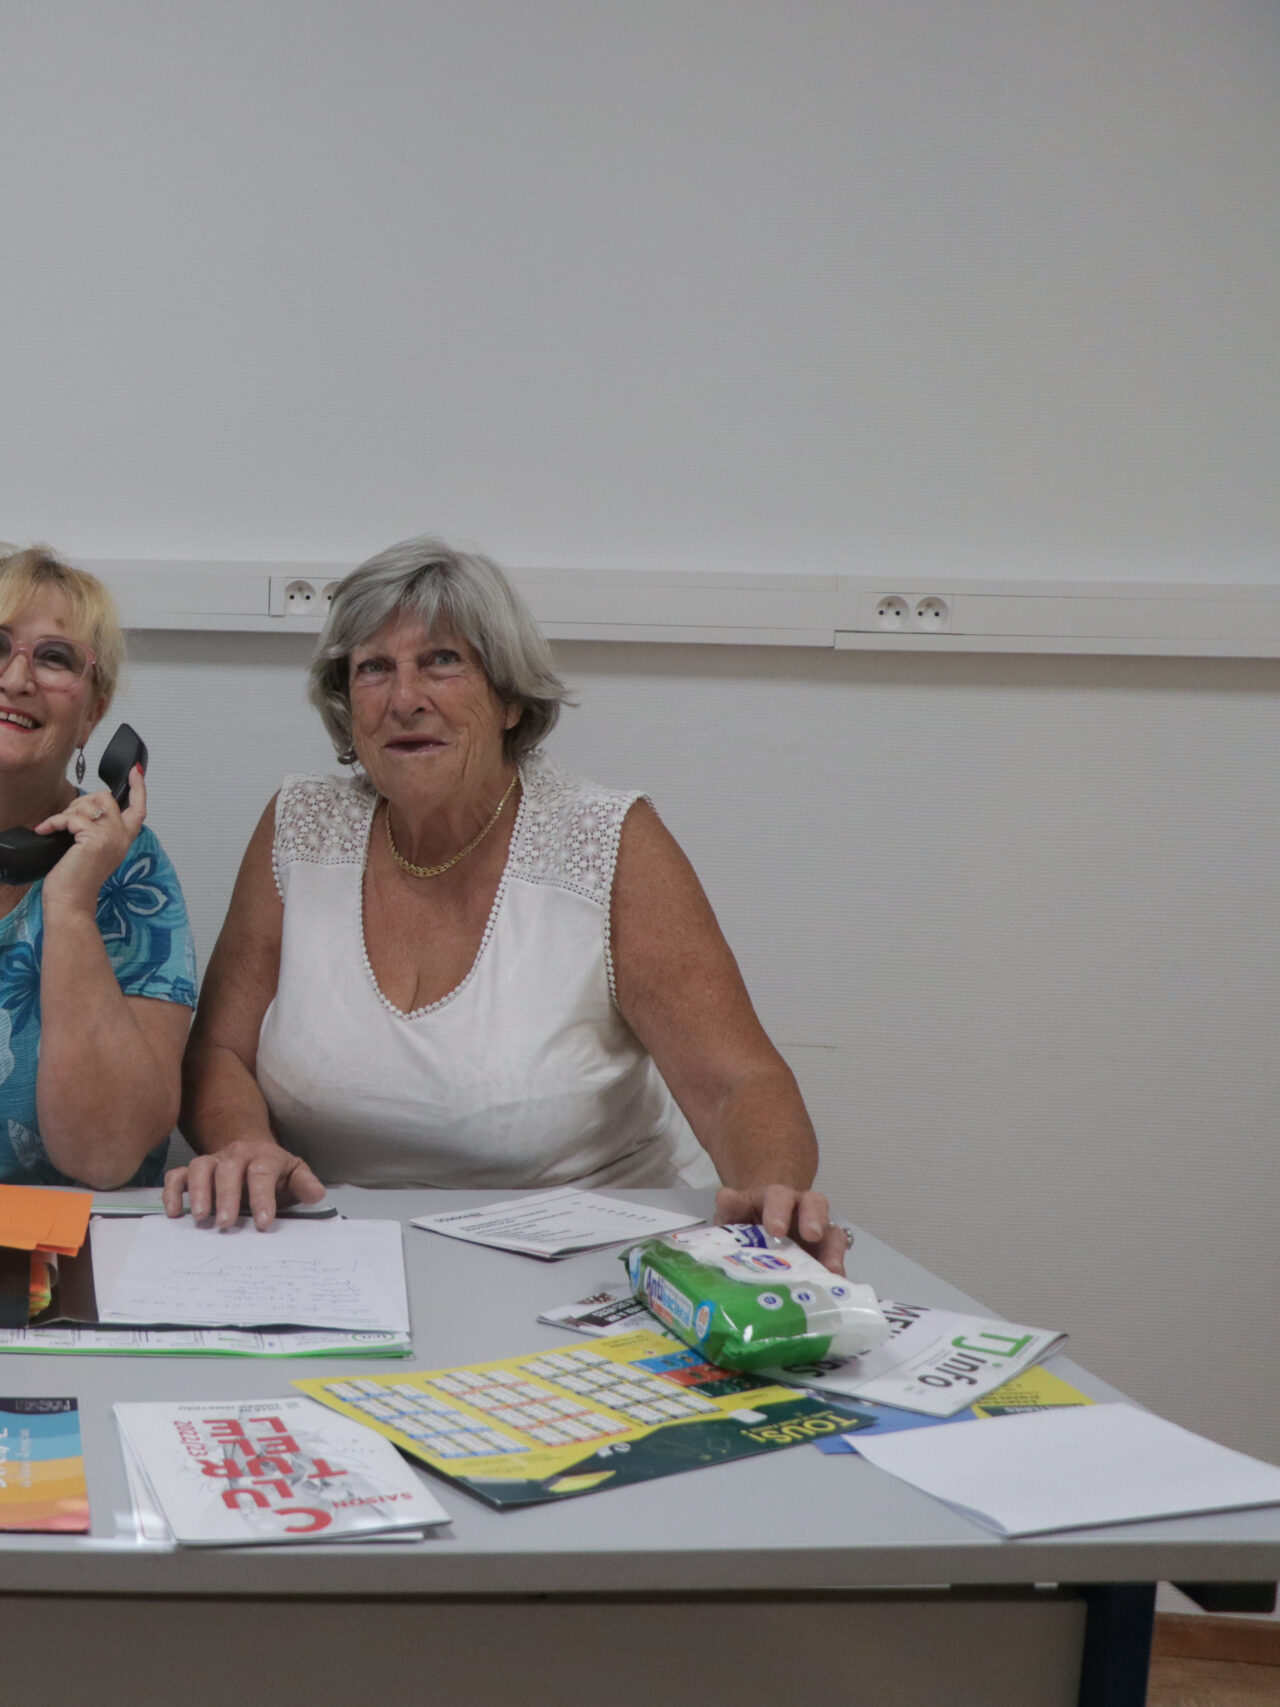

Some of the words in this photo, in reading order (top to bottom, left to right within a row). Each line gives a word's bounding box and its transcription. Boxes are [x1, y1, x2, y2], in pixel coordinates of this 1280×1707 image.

[917, 1352, 1003, 1389] info
[173, 1420, 209, 1458] 2022/23
[332, 1491, 414, 1510] SAISON
